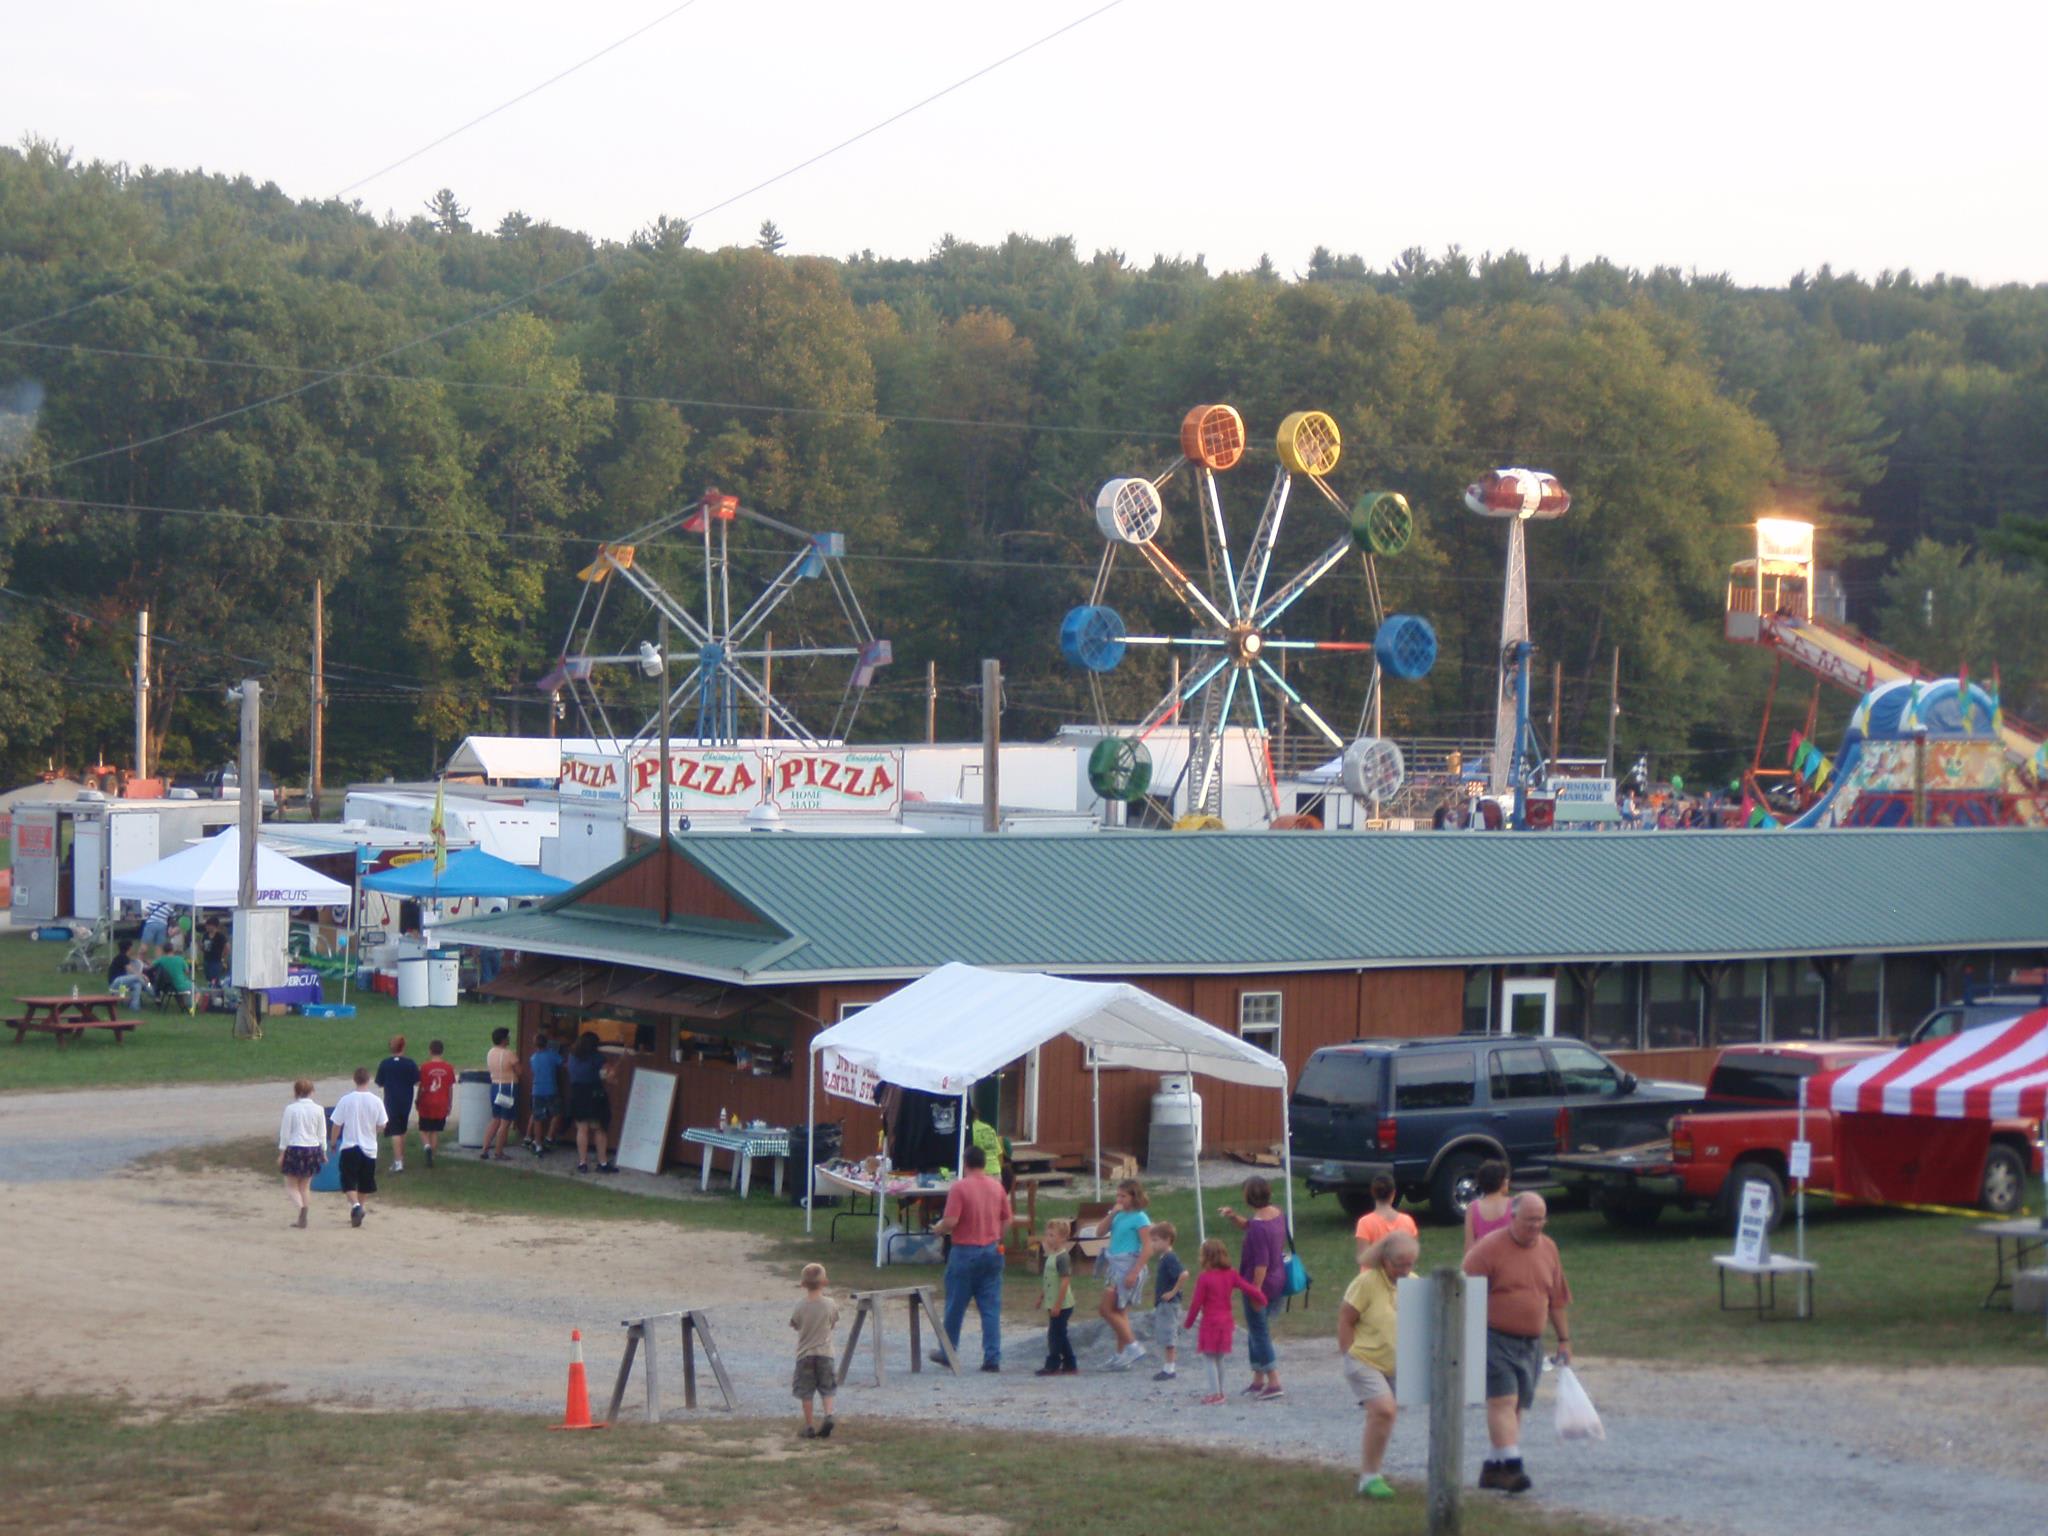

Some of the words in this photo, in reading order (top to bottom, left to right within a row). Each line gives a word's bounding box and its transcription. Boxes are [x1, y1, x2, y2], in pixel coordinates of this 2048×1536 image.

[560, 759, 617, 788] PIZZA
[634, 756, 756, 796] PIZZA
[779, 757, 894, 797] PIZZA
[652, 791, 684, 800] HME
[791, 790, 822, 800] HOME
[652, 801, 684, 810] MDE
[790, 801, 822, 810] MADE
[256, 889, 308, 901] UPERCUTS
